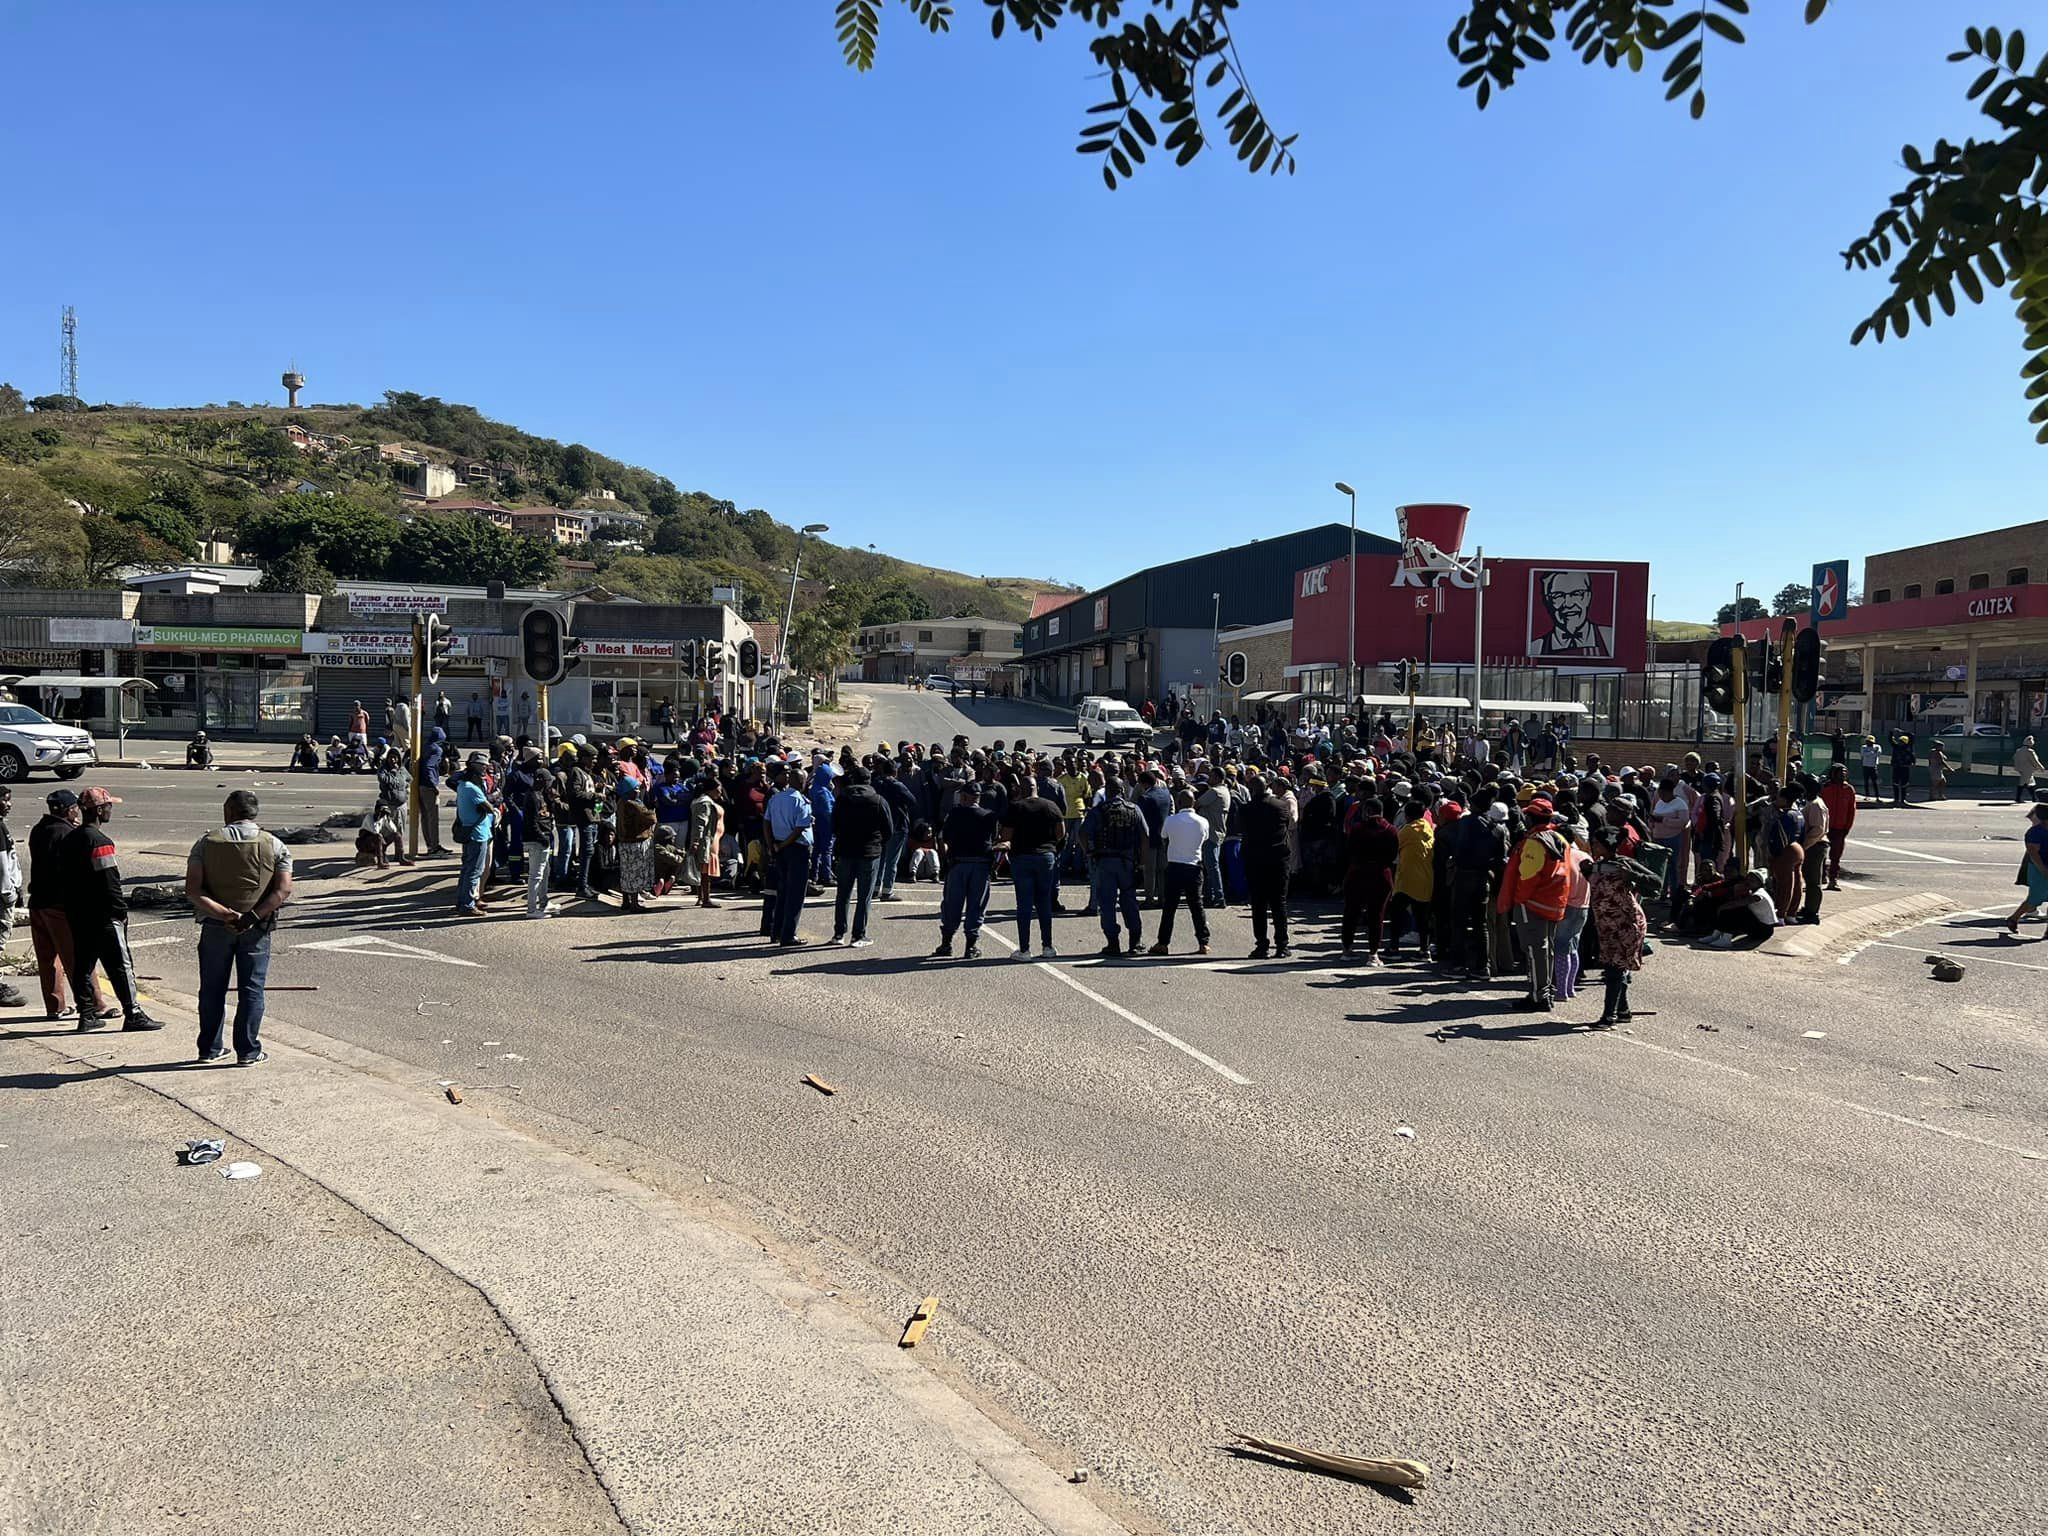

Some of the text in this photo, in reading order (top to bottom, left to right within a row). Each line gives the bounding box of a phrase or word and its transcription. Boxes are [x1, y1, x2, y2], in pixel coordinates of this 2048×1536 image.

[1301, 566, 1329, 598] KFC
[1968, 596, 2014, 617] CALTEX
[154, 631, 298, 644] SUKHU-MED PHARMACY
[383, 636, 459, 644] CELAR
[595, 643, 626, 654] Meat
[632, 644, 673, 655] Market
[320, 655, 386, 666] YEBO CELLULA
